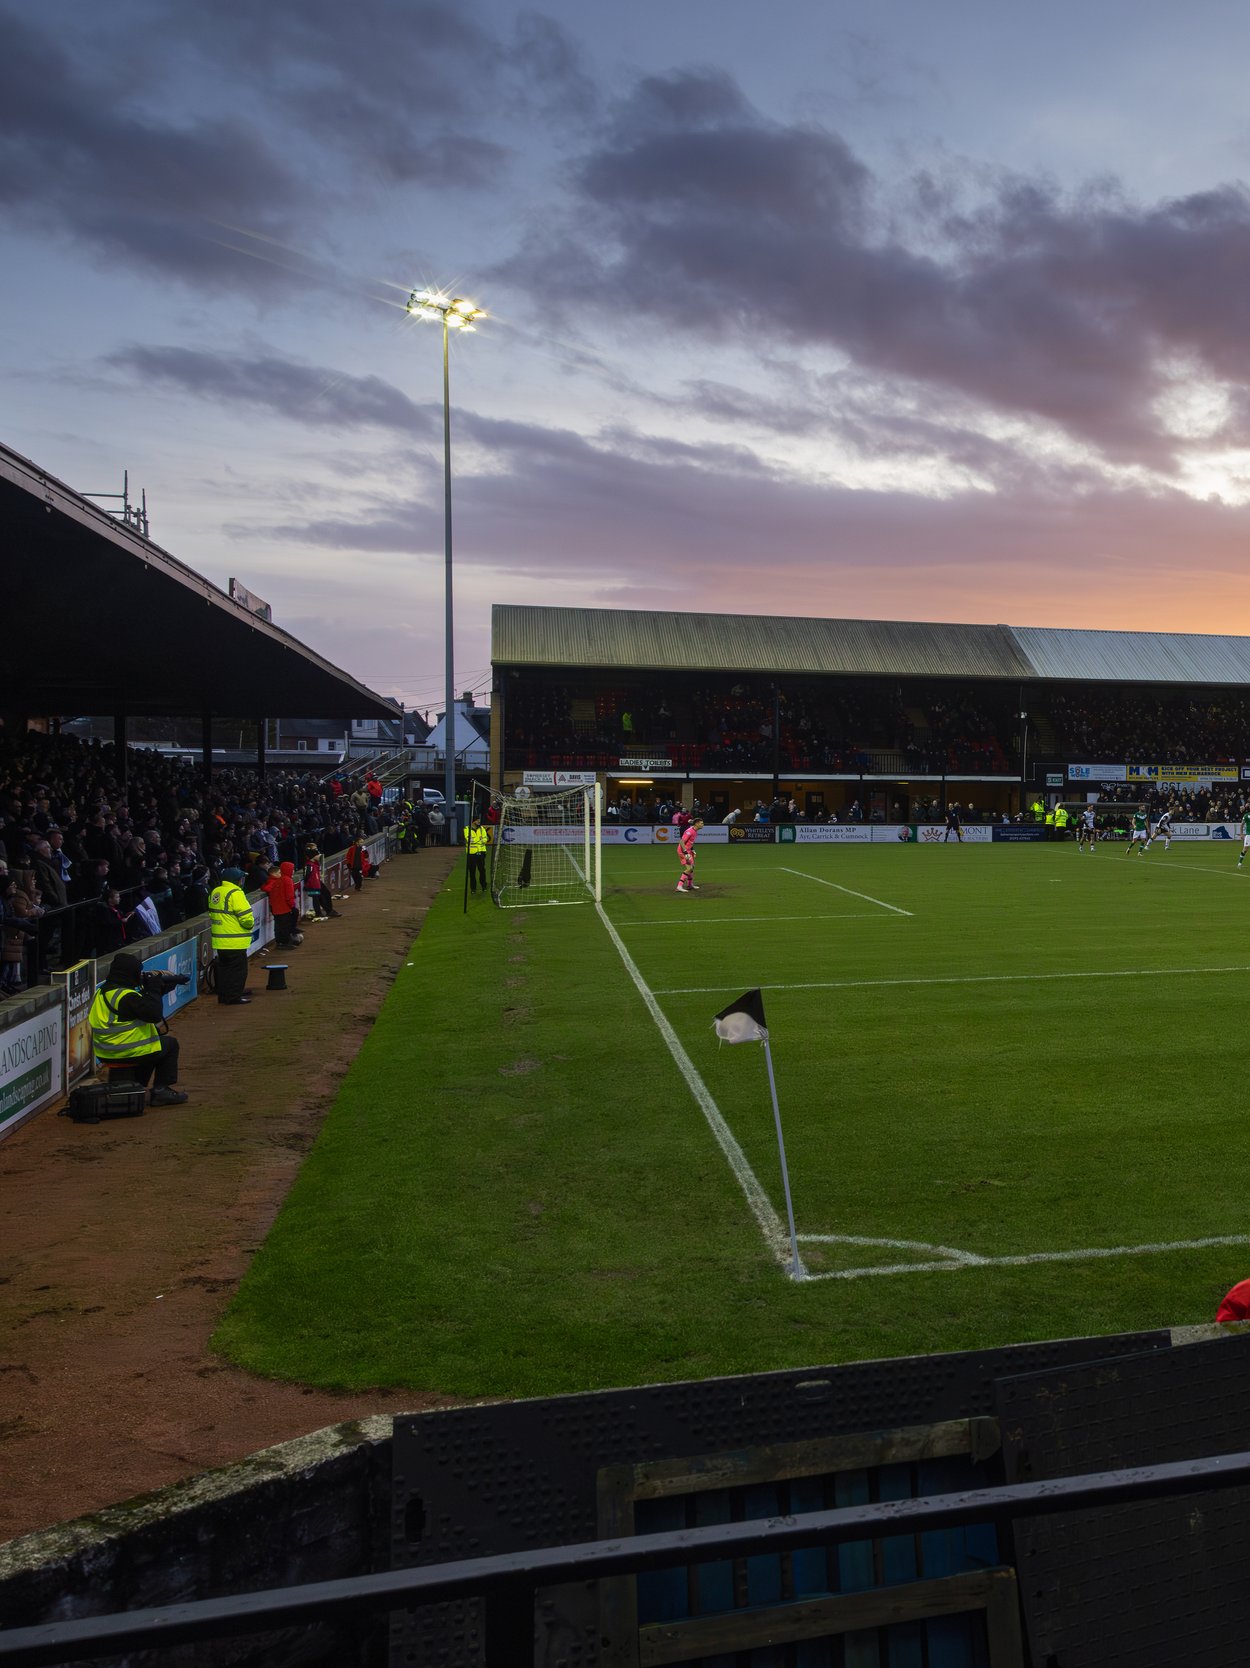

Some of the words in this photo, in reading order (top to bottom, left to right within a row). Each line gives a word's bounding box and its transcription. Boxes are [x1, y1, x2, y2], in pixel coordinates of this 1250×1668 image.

[1129, 767, 1159, 776] MKM
[1179, 826, 1200, 834] Lane
[0, 1022, 58, 1077] ANDSCAPING
